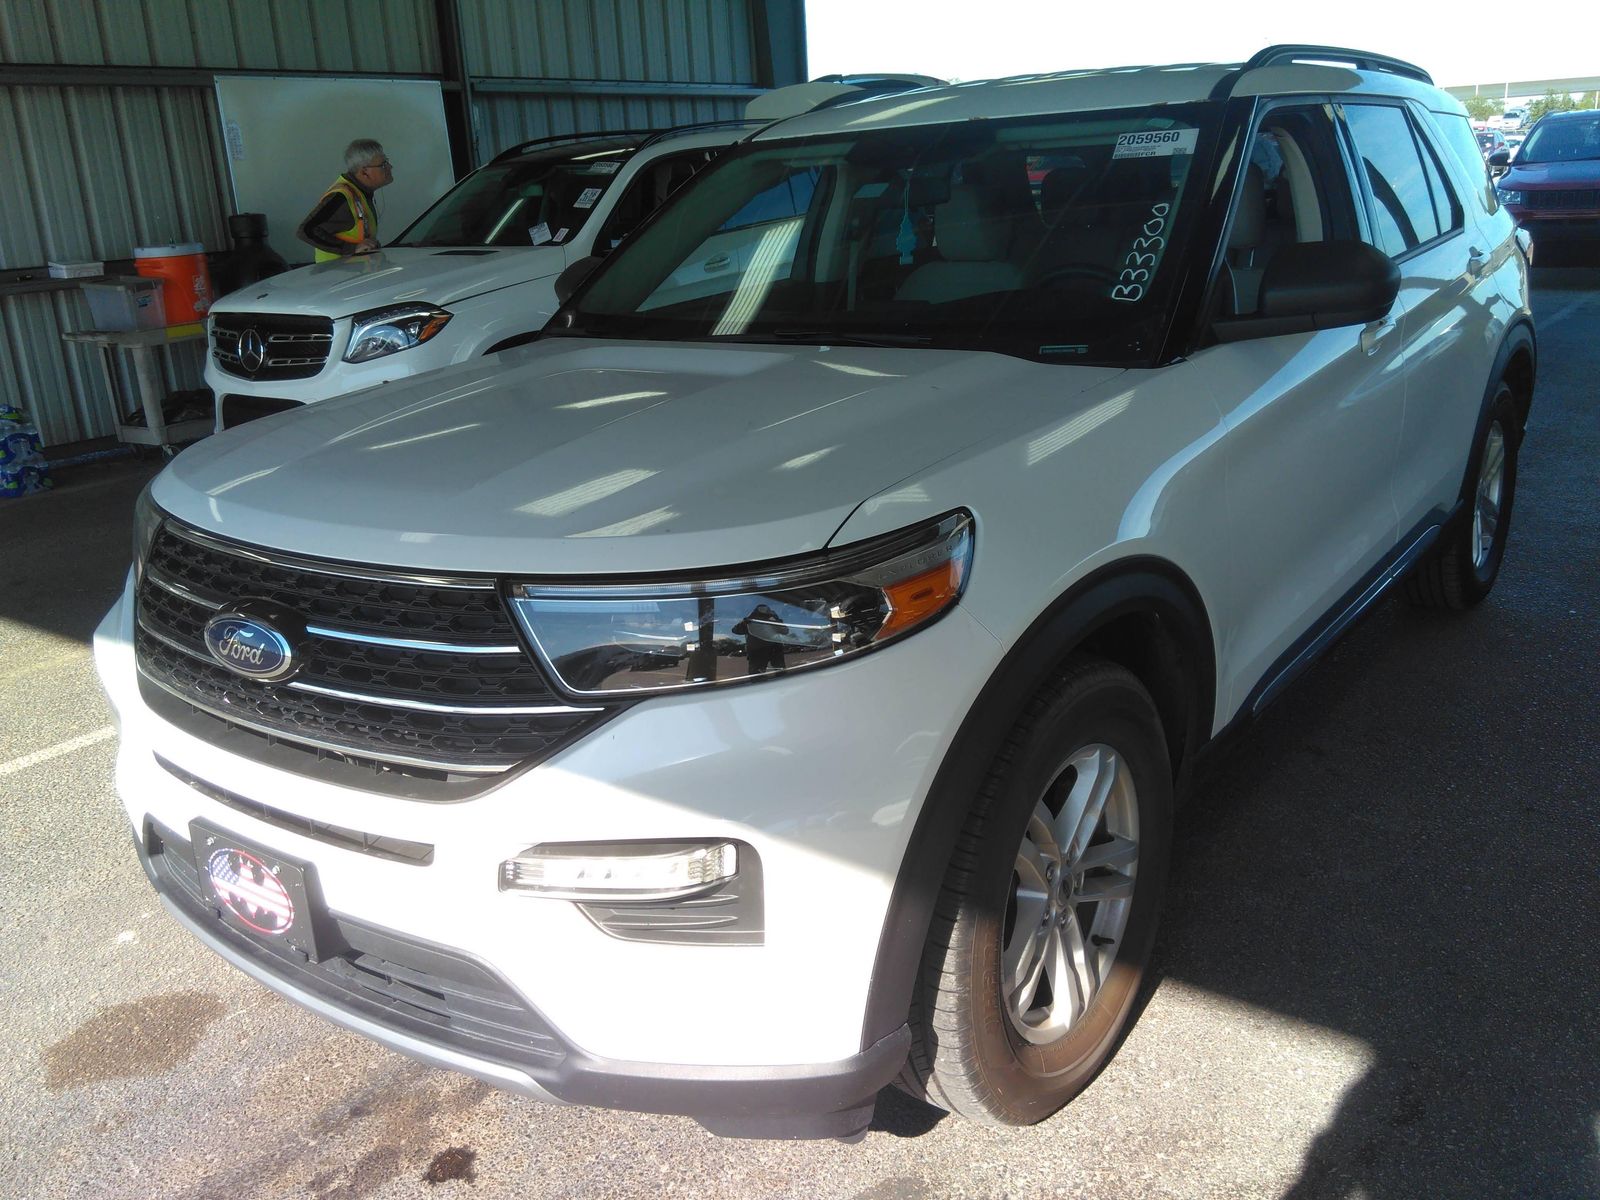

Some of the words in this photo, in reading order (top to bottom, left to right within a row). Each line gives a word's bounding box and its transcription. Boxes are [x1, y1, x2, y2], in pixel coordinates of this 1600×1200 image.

[1118, 131, 1180, 146] 2059560
[1112, 203, 1170, 301] B33300
[220, 626, 266, 665] Ford
